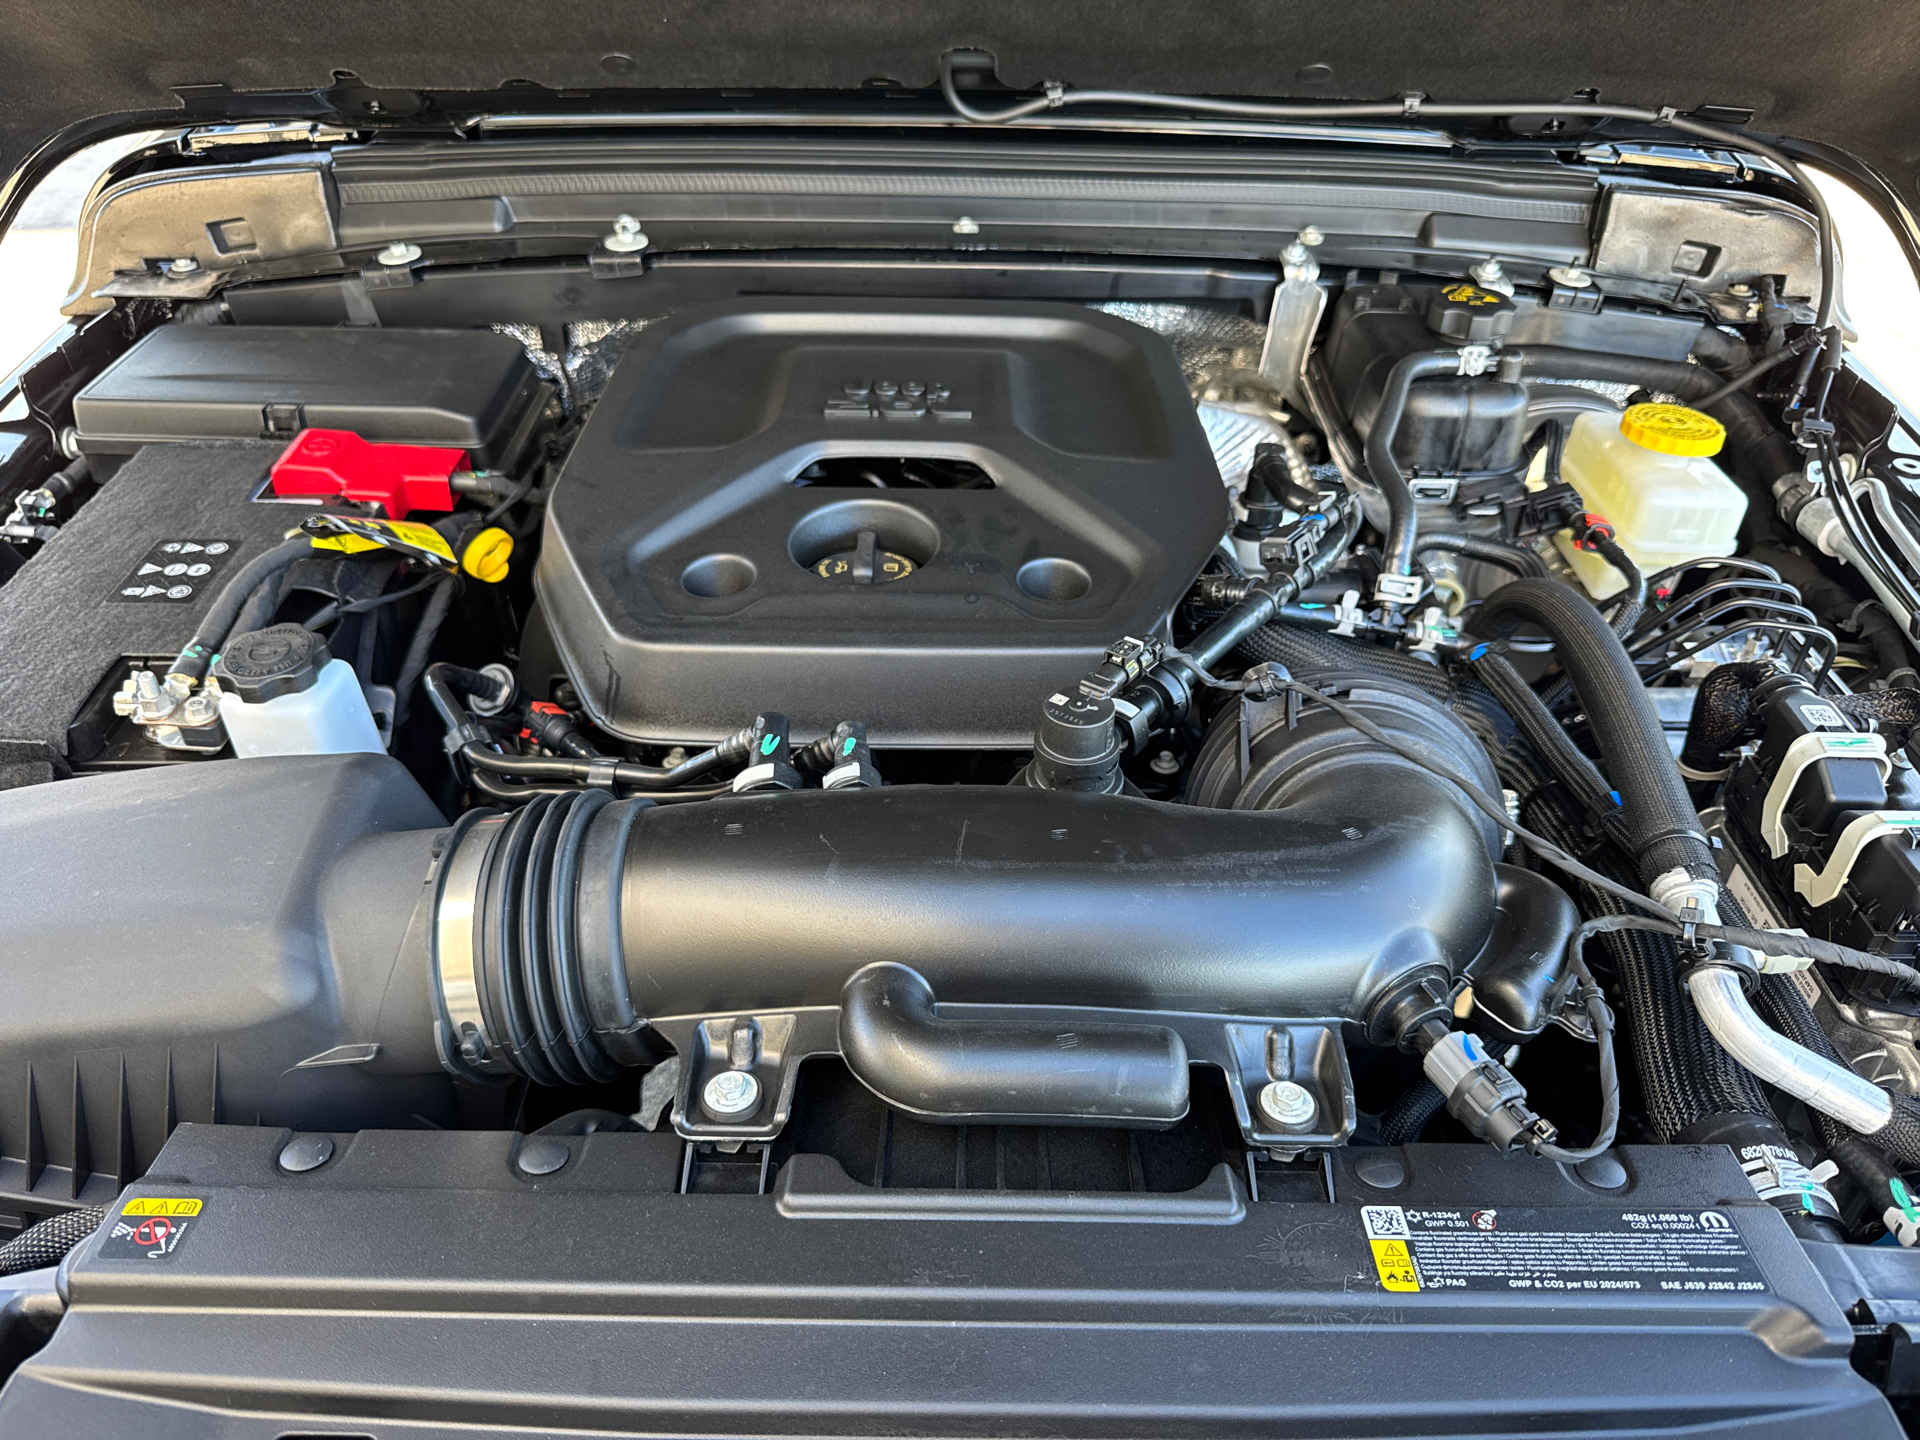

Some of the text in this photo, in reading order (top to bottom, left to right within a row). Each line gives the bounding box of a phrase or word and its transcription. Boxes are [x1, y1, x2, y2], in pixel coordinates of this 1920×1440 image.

[844, 377, 951, 403] Jeep
[824, 398, 972, 419] 2.0L
[1741, 1146, 1798, 1162] 682781AD
[1622, 1214, 1647, 1223] 482g
[1648, 1214, 1678, 1222] (1.060
[1660, 1281, 1682, 1289] SAE
